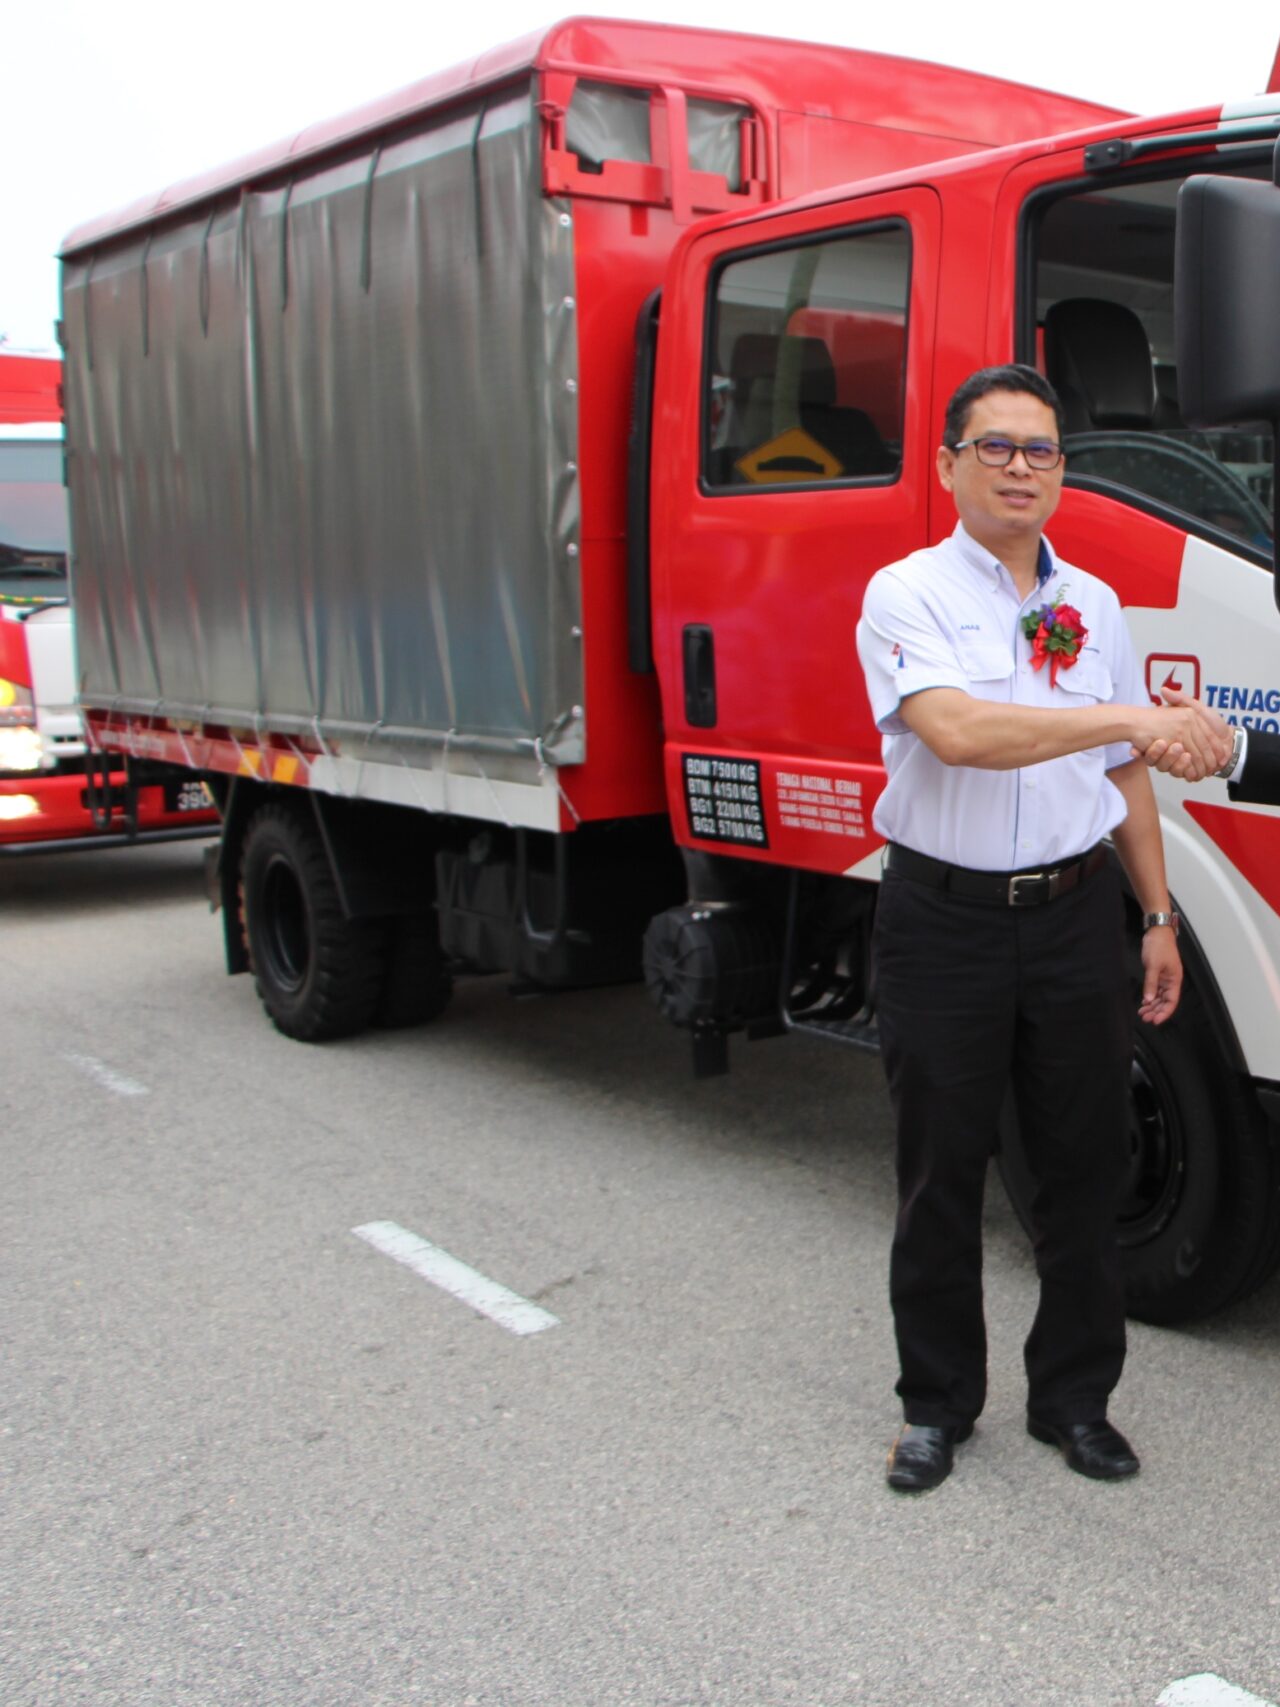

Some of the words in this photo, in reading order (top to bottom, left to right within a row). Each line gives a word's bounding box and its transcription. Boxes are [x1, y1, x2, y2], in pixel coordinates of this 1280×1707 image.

[686, 757, 711, 776] BDM
[712, 760, 738, 779] 7500
[739, 764, 757, 782] KG
[713, 780, 739, 799] 4150
[740, 783, 759, 802] KG
[690, 796, 713, 815] BG1
[715, 800, 742, 818] 2200
[743, 803, 761, 822] KG
[692, 815, 716, 834] BG2
[718, 819, 745, 838] 5700
[746, 823, 764, 842] KG
